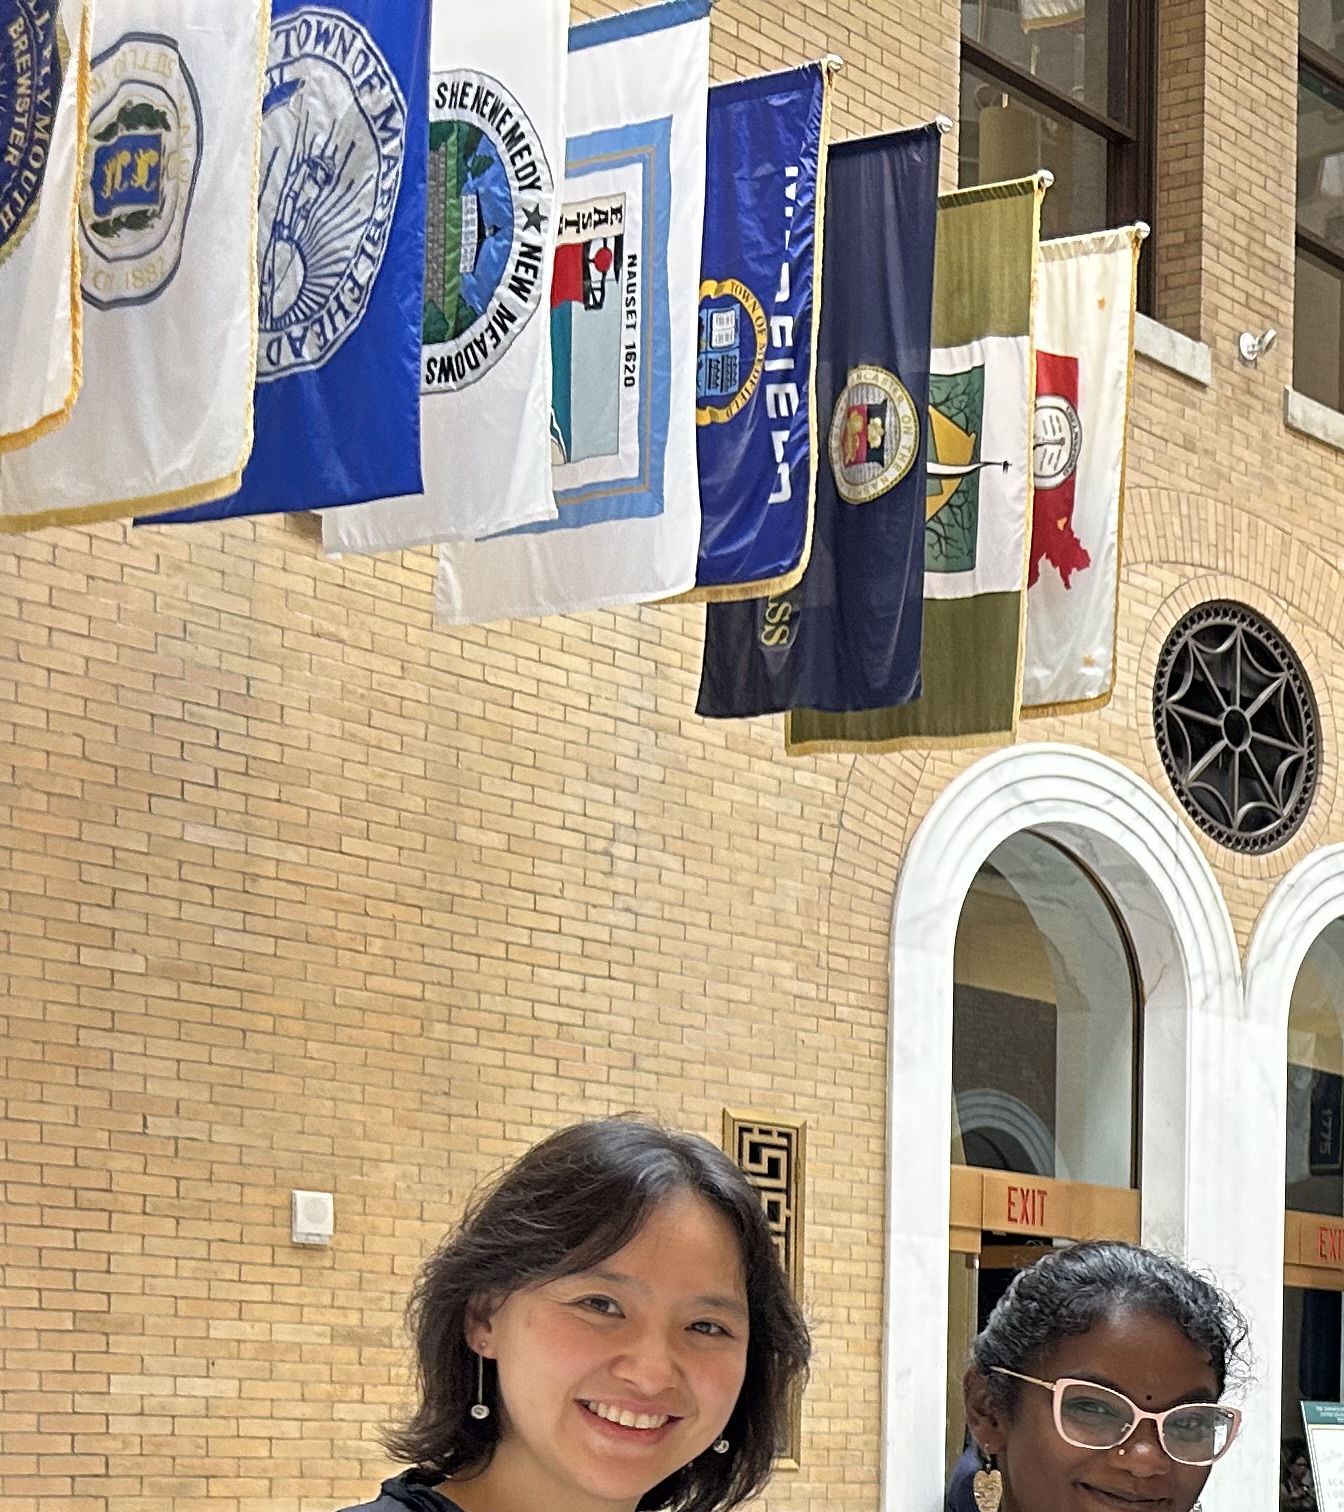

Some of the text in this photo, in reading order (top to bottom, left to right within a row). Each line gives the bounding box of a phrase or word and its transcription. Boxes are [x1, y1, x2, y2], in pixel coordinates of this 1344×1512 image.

[4, 16, 33, 166] BREWSTER
[274, 18, 357, 64] TOWN
[354, 54, 387, 99] OF
[557, 204, 623, 236] EAST
[424, 243, 543, 386] NEW MEADOWS
[624, 253, 639, 389] NAUSET 1620
[730, 281, 760, 316] TOWN
[757, 316, 767, 336] OF
[1007, 1186, 1048, 1228] EXIT
